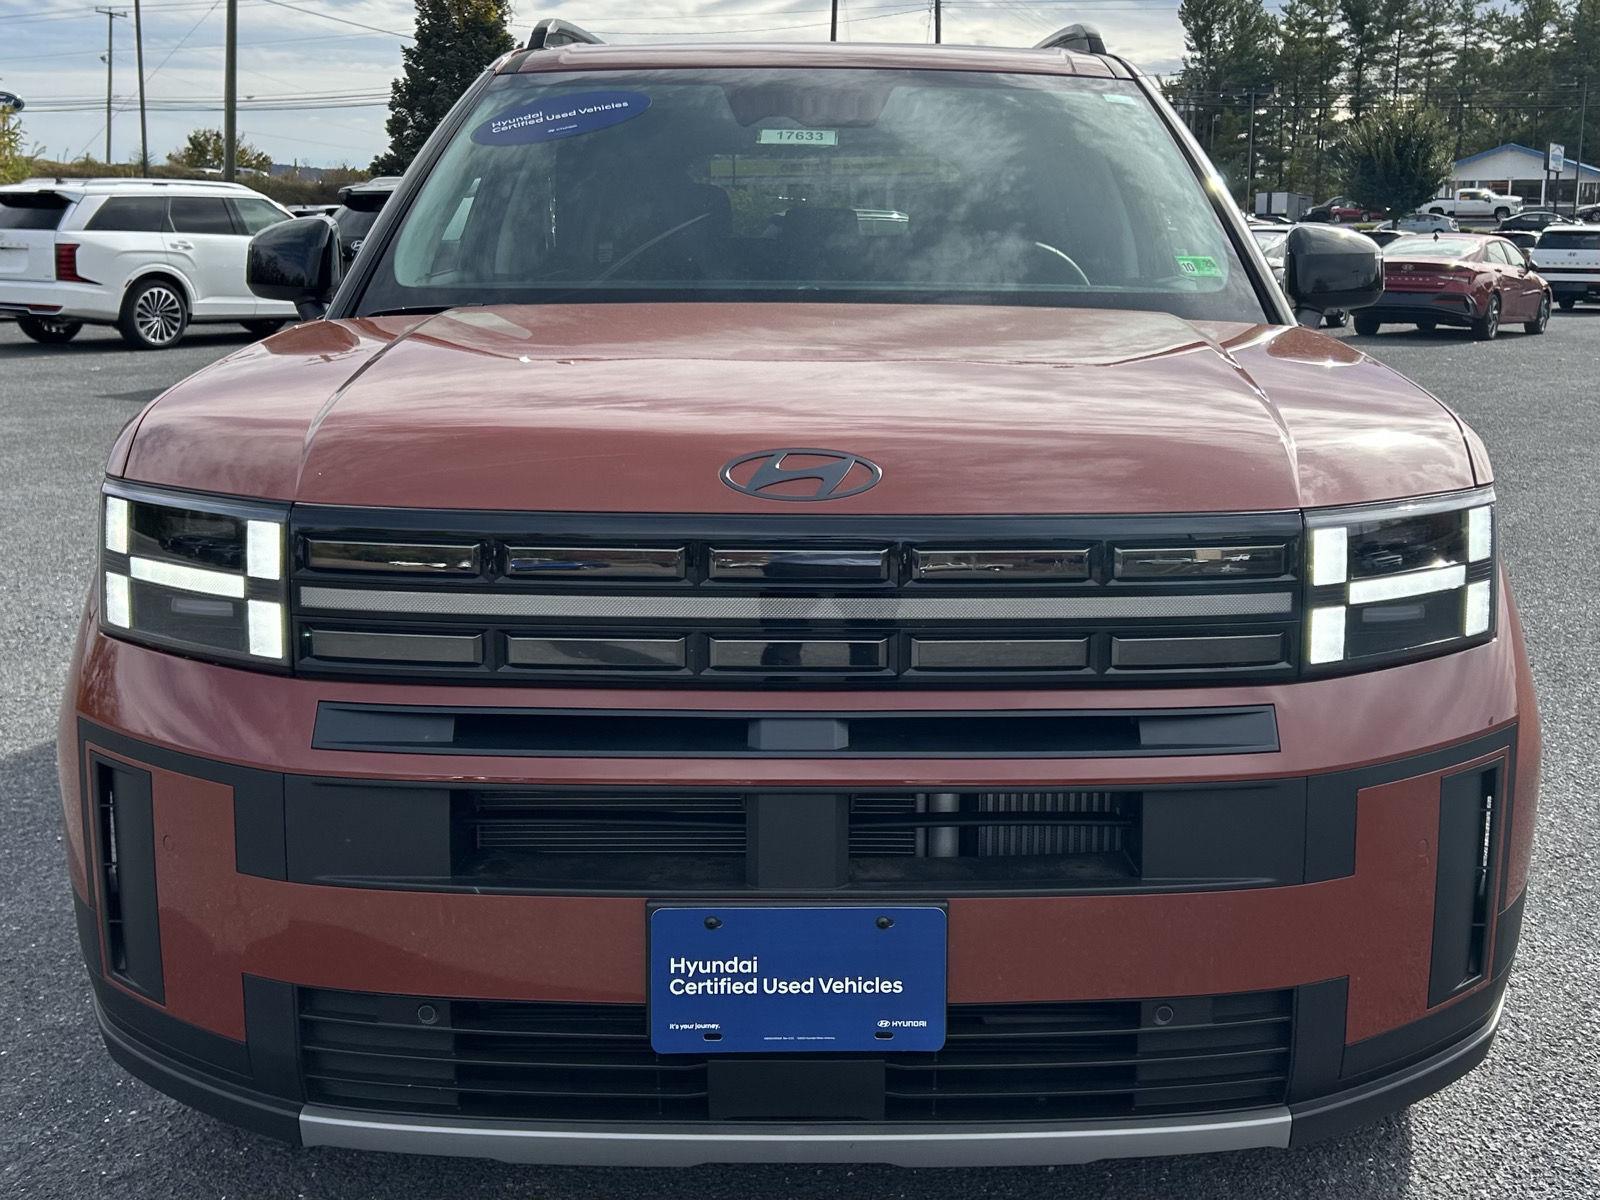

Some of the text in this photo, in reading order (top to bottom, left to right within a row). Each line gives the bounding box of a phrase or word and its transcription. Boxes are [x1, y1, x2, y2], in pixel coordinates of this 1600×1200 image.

[491, 111, 543, 127] Hyundai
[492, 117, 544, 133] Certified
[546, 109, 577, 121] Used
[578, 101, 629, 114] Vehicles
[776, 130, 824, 141] 17633
[1181, 262, 1195, 272] 10
[669, 956, 759, 976] Hyundai
[669, 976, 904, 994] Certified Used Vehicles
[694, 1022, 721, 1031] journey.
[891, 1020, 928, 1028] HYUNDAI
